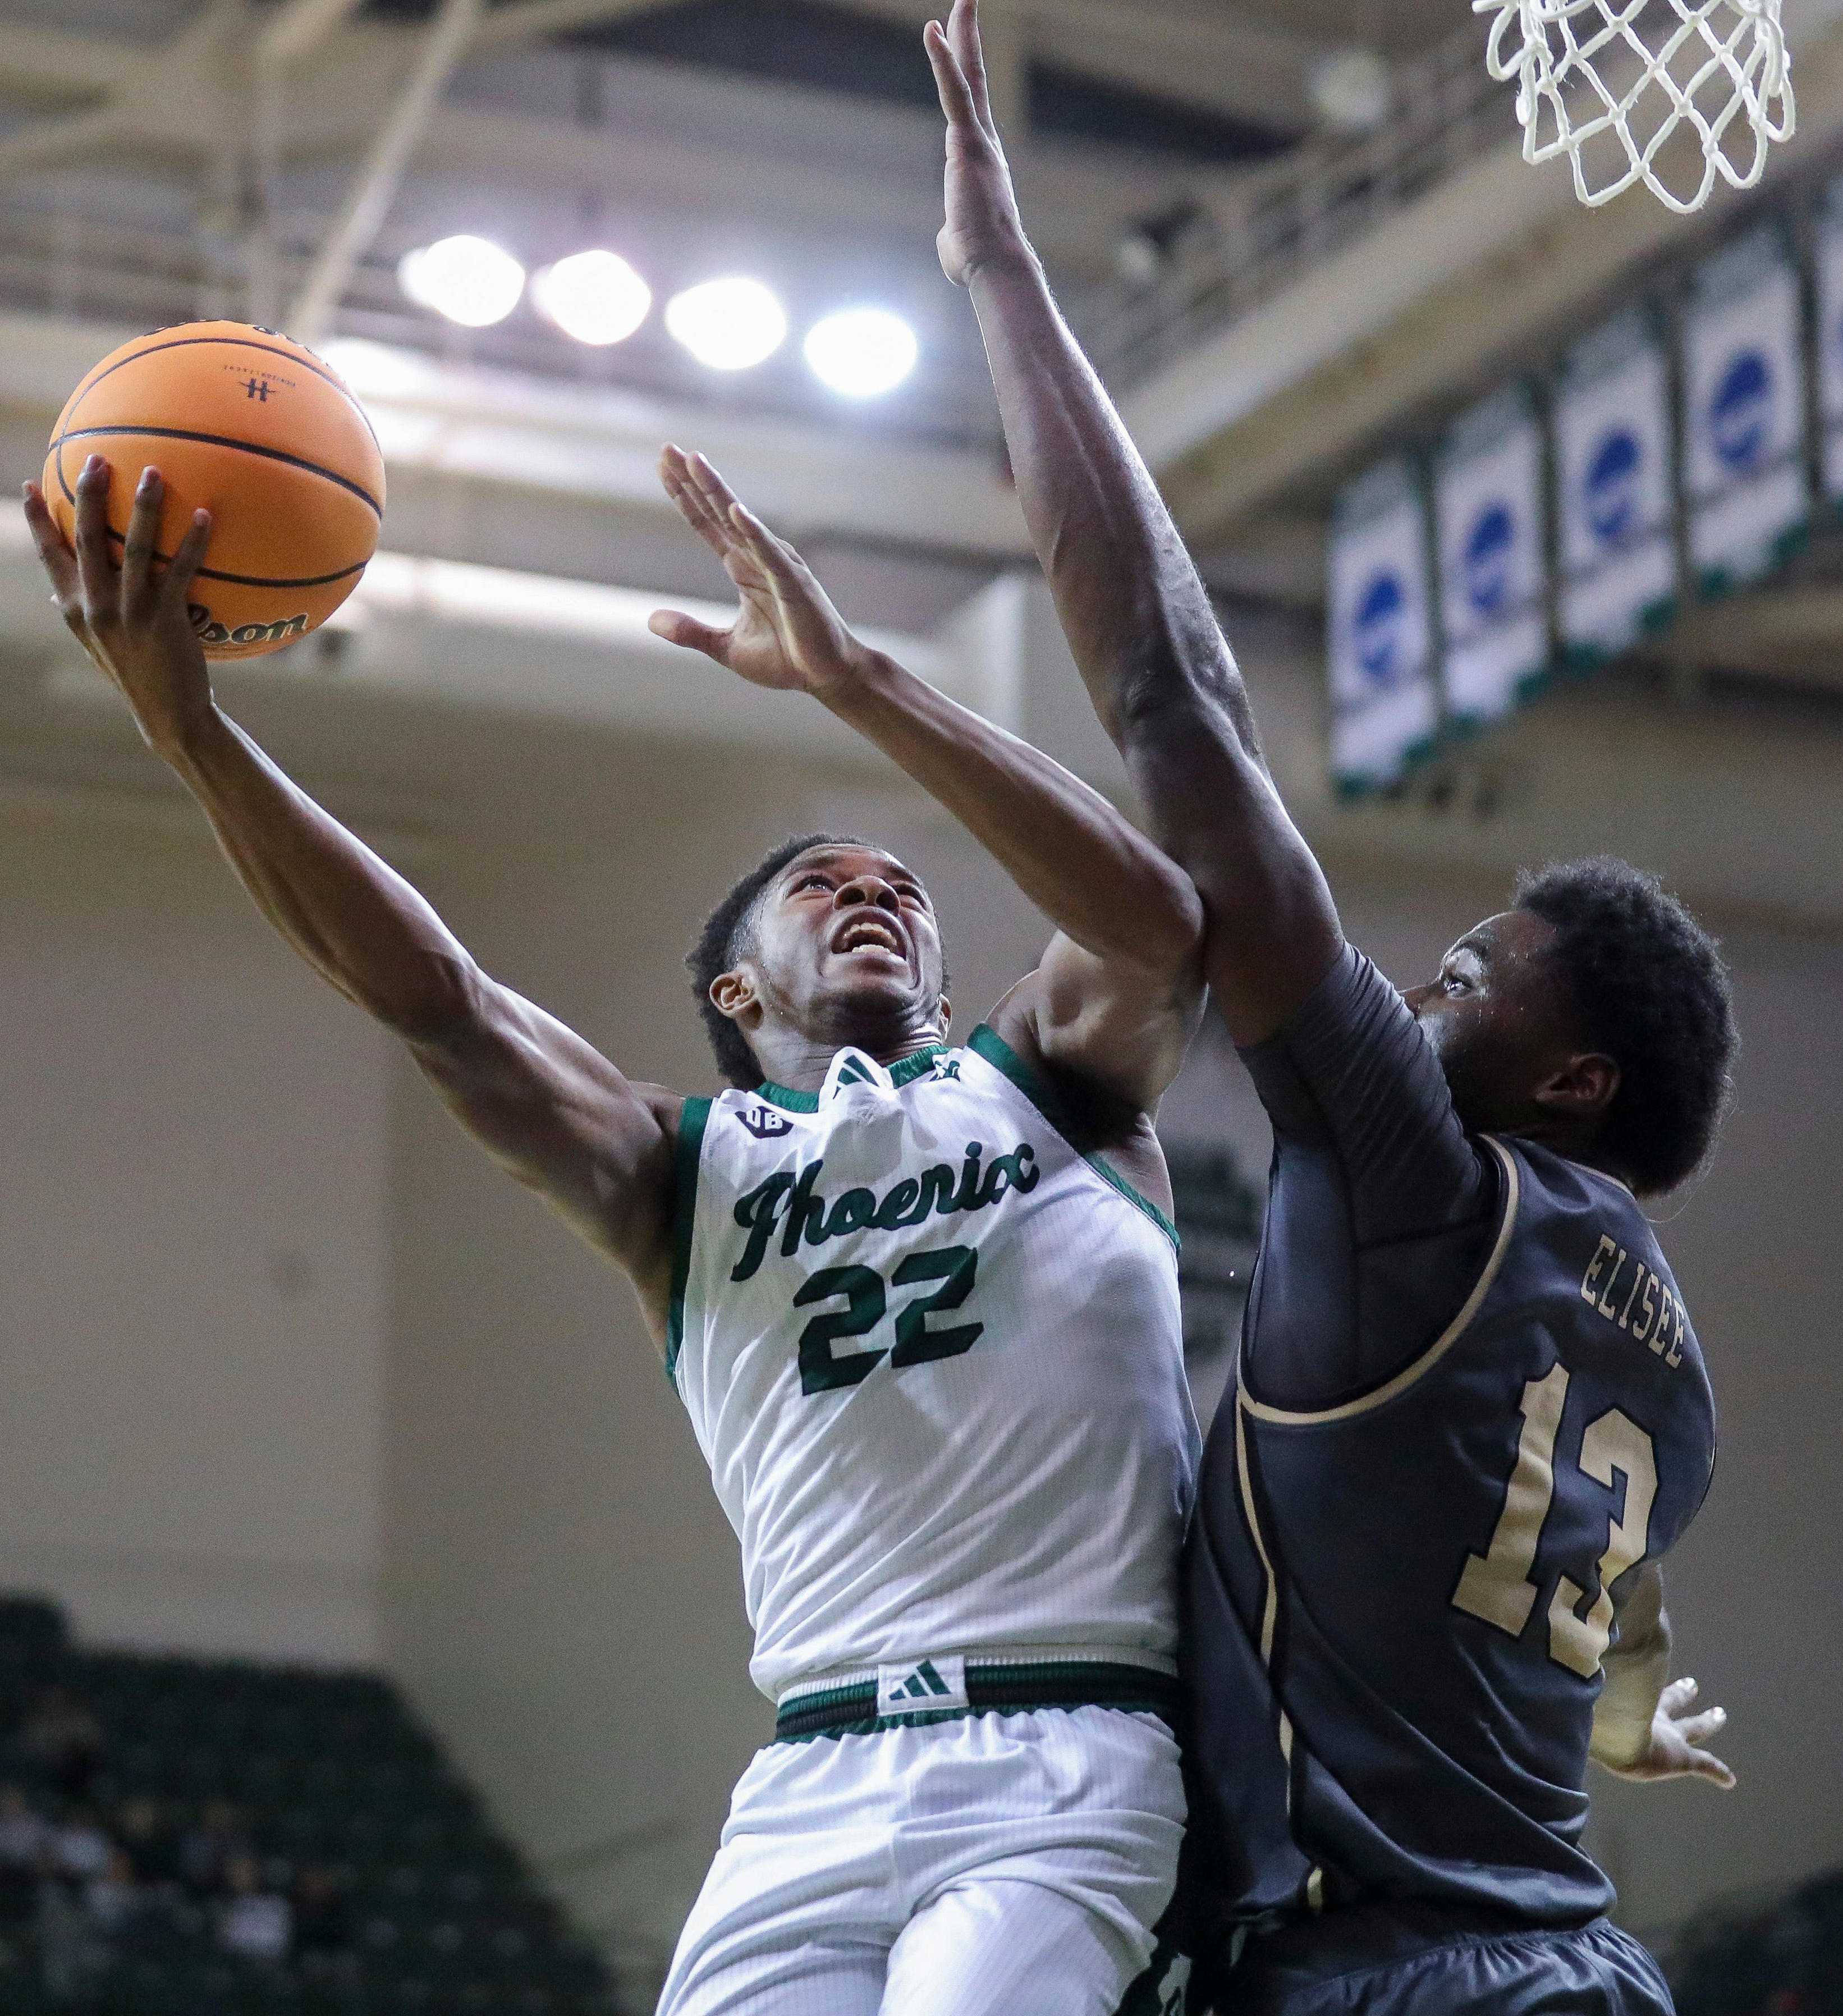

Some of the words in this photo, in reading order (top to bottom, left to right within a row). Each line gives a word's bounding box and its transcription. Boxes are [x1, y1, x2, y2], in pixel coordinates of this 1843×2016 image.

[731, 1141, 1040, 1282] Phoenix
[793, 1245, 984, 1396] 22
[1580, 1234, 1684, 1369] ELISEE
[1451, 1362, 1657, 1679] 13
